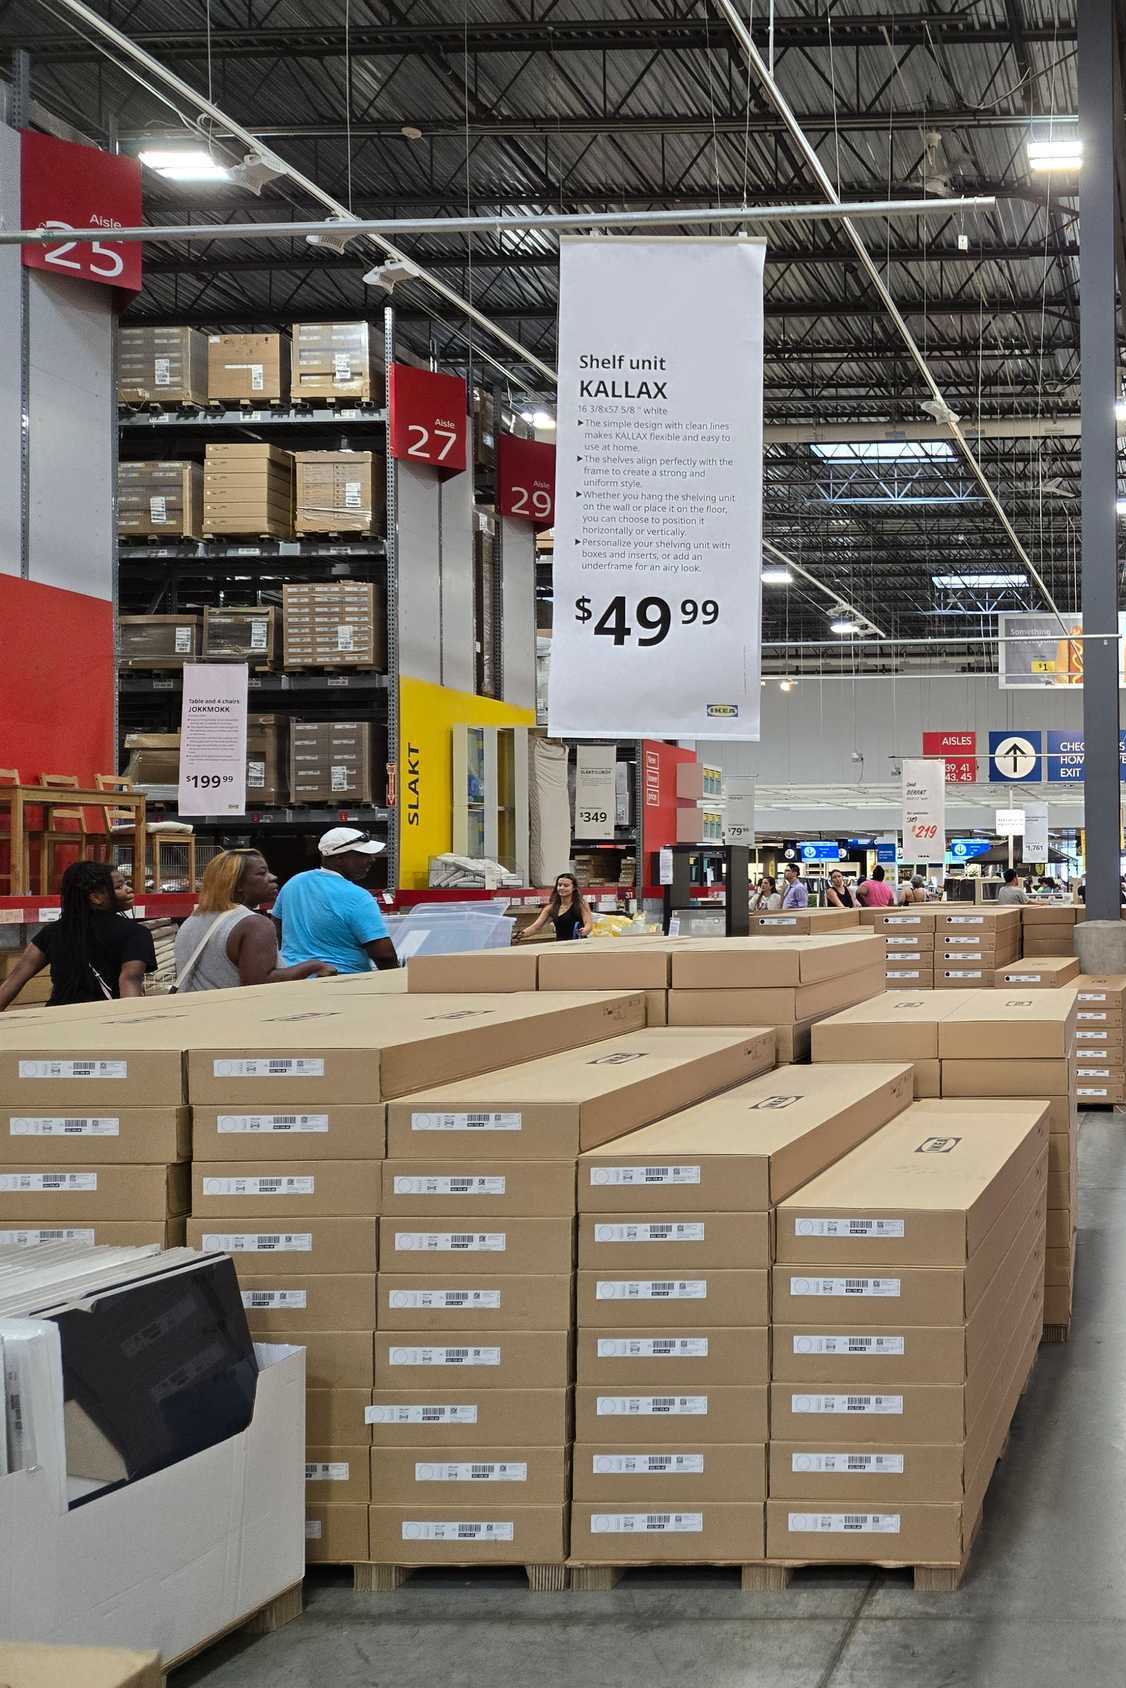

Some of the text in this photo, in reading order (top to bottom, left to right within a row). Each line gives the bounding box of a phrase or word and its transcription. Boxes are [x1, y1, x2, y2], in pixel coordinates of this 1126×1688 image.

[90, 214, 122, 230] Aisle
[45, 220, 124, 276] 25
[579, 354, 666, 371] Shelf unit
[579, 380, 668, 400] KALLAX
[590, 406, 617, 414] 3/8x57
[621, 406, 635, 414] 5/8
[644, 406, 668, 415] white
[434, 418, 456, 428] Aisle
[602, 419, 632, 429] simple
[634, 420, 662, 430] design
[665, 421, 683, 429] with
[685, 421, 707, 430] clean
[710, 422, 729, 430] lines
[408, 425, 457, 460] 27
[584, 431, 613, 440] makes
[615, 432, 647, 440] KALLAX
[650, 432, 680, 441] flexible
[682, 433, 698, 442] and
[701, 435, 719, 443] easy
[584, 455, 733, 467] The shelves align perfectly with the
[584, 466, 609, 475] frame
[623, 468, 649, 476] create
[659, 469, 687, 479] strong
[690, 469, 705, 477] and
[533, 480, 550, 489] Aisle
[584, 478, 618, 487] uniform
[511, 486, 550, 517] 29
[584, 491, 620, 499] Whether
[641, 492, 663, 502] hang
[665, 492, 679, 500] the
[681, 493, 716, 503] shelving
[719, 494, 735, 502] unit
[597, 503, 611, 511] the
[613, 503, 630, 511] wall
[644, 504, 666, 513] place
[619, 514, 649, 523] choose
[663, 516, 696, 525] position
[583, 526, 633, 536] horizontally
[582, 538, 730, 550] Personalize your shelving unit with
[582, 550, 607, 558] boxes
[609, 550, 625, 558] and
[673, 551, 689, 560] add
[582, 561, 633, 570] underframe
[635, 562, 647, 570] for
[663, 563, 679, 573] airy
[942, 737, 972, 745] AISLES
[960, 764, 970, 772] 41
[1060, 768, 1081, 777] EXIT
[960, 773, 972, 781] 45
[408, 742, 420, 826] SLAKT
[580, 812, 607, 823] $349
